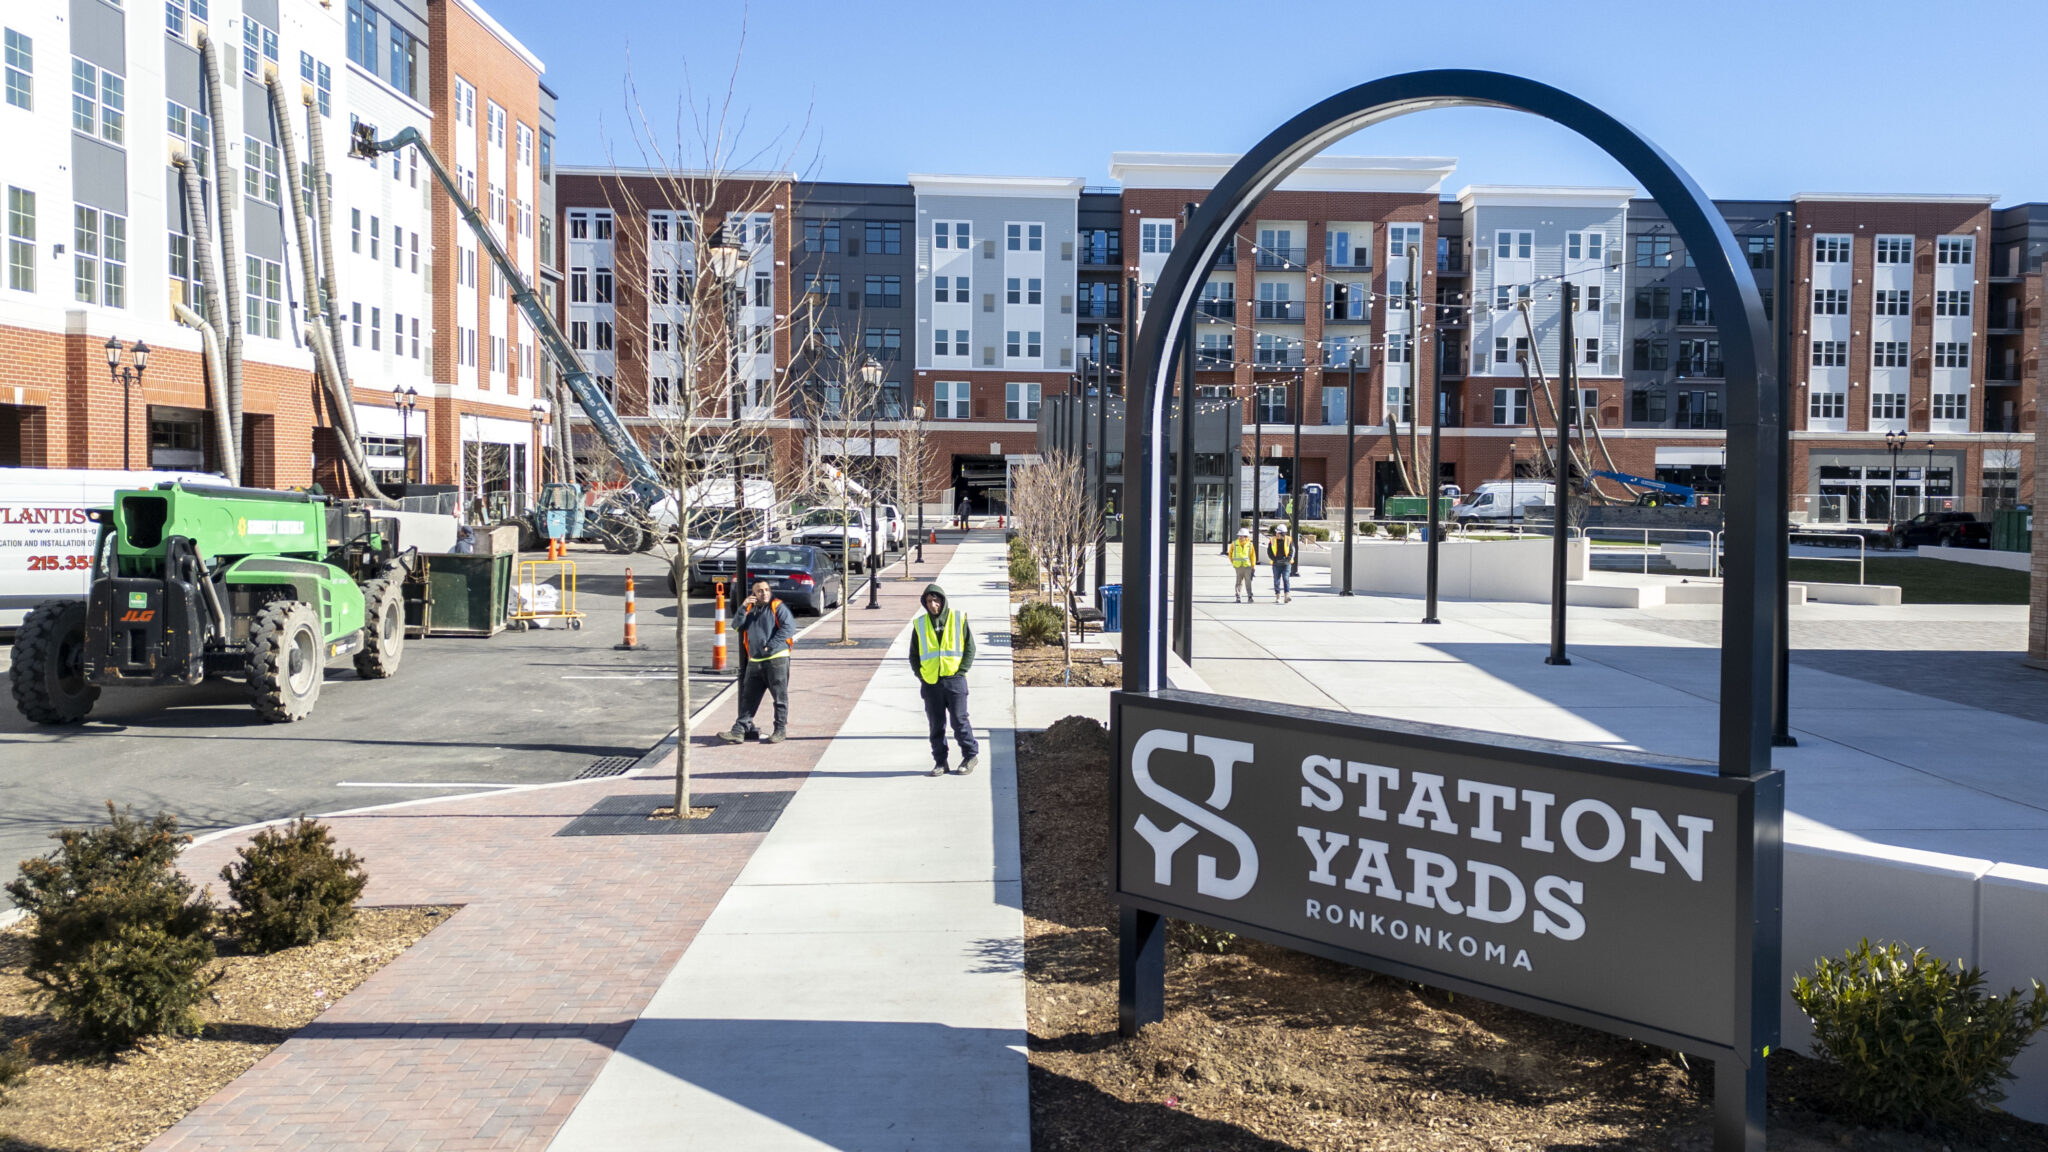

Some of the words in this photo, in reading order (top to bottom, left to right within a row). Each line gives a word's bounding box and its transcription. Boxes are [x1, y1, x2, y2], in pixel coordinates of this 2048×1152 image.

[0, 508, 87, 524] LANTIS
[24, 539, 38, 547] AND
[40, 539, 86, 547] INSTALLATION
[120, 610, 155, 622] JLG
[1301, 754, 1714, 882] STATION
[1297, 826, 1587, 941] YARDS
[1305, 898, 1533, 972] RONKONKOMA
